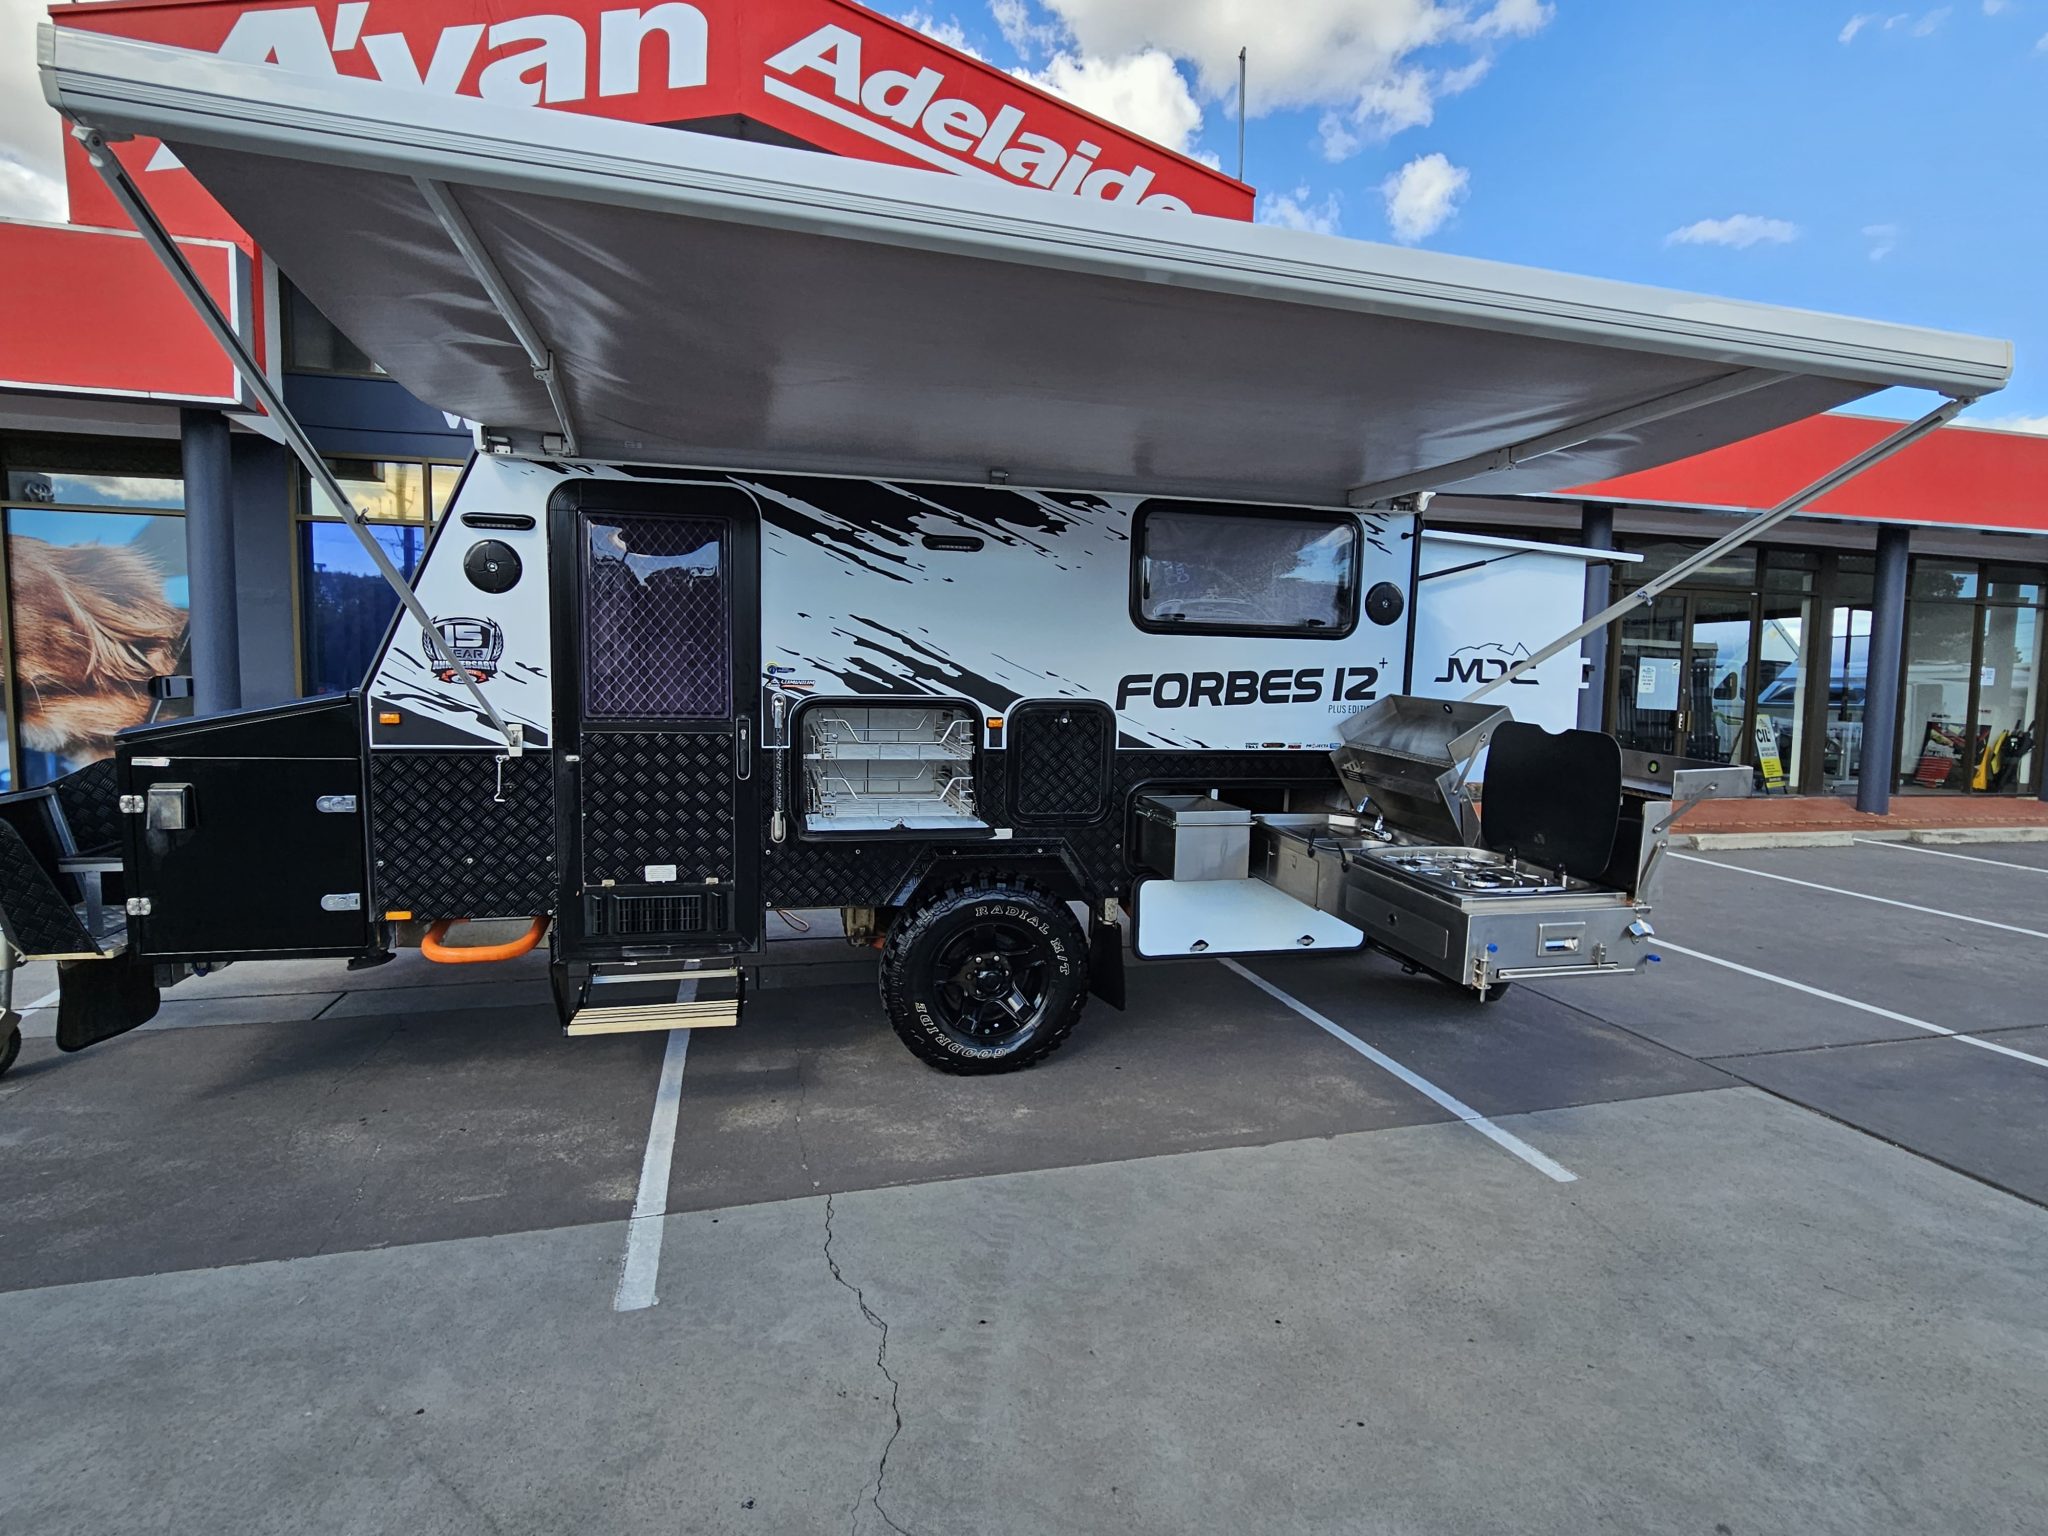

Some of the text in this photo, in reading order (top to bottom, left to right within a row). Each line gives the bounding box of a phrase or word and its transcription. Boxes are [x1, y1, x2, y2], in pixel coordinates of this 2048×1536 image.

[217, 2, 708, 107] A'van
[444, 625, 482, 648] 15
[453, 649, 483, 659] EAR
[1115, 668, 1324, 711] FORBES
[1328, 704, 1346, 714] PLUS
[975, 905, 1070, 975] RADIAL M/T
[915, 1002, 1007, 1059] GOODRIDE
